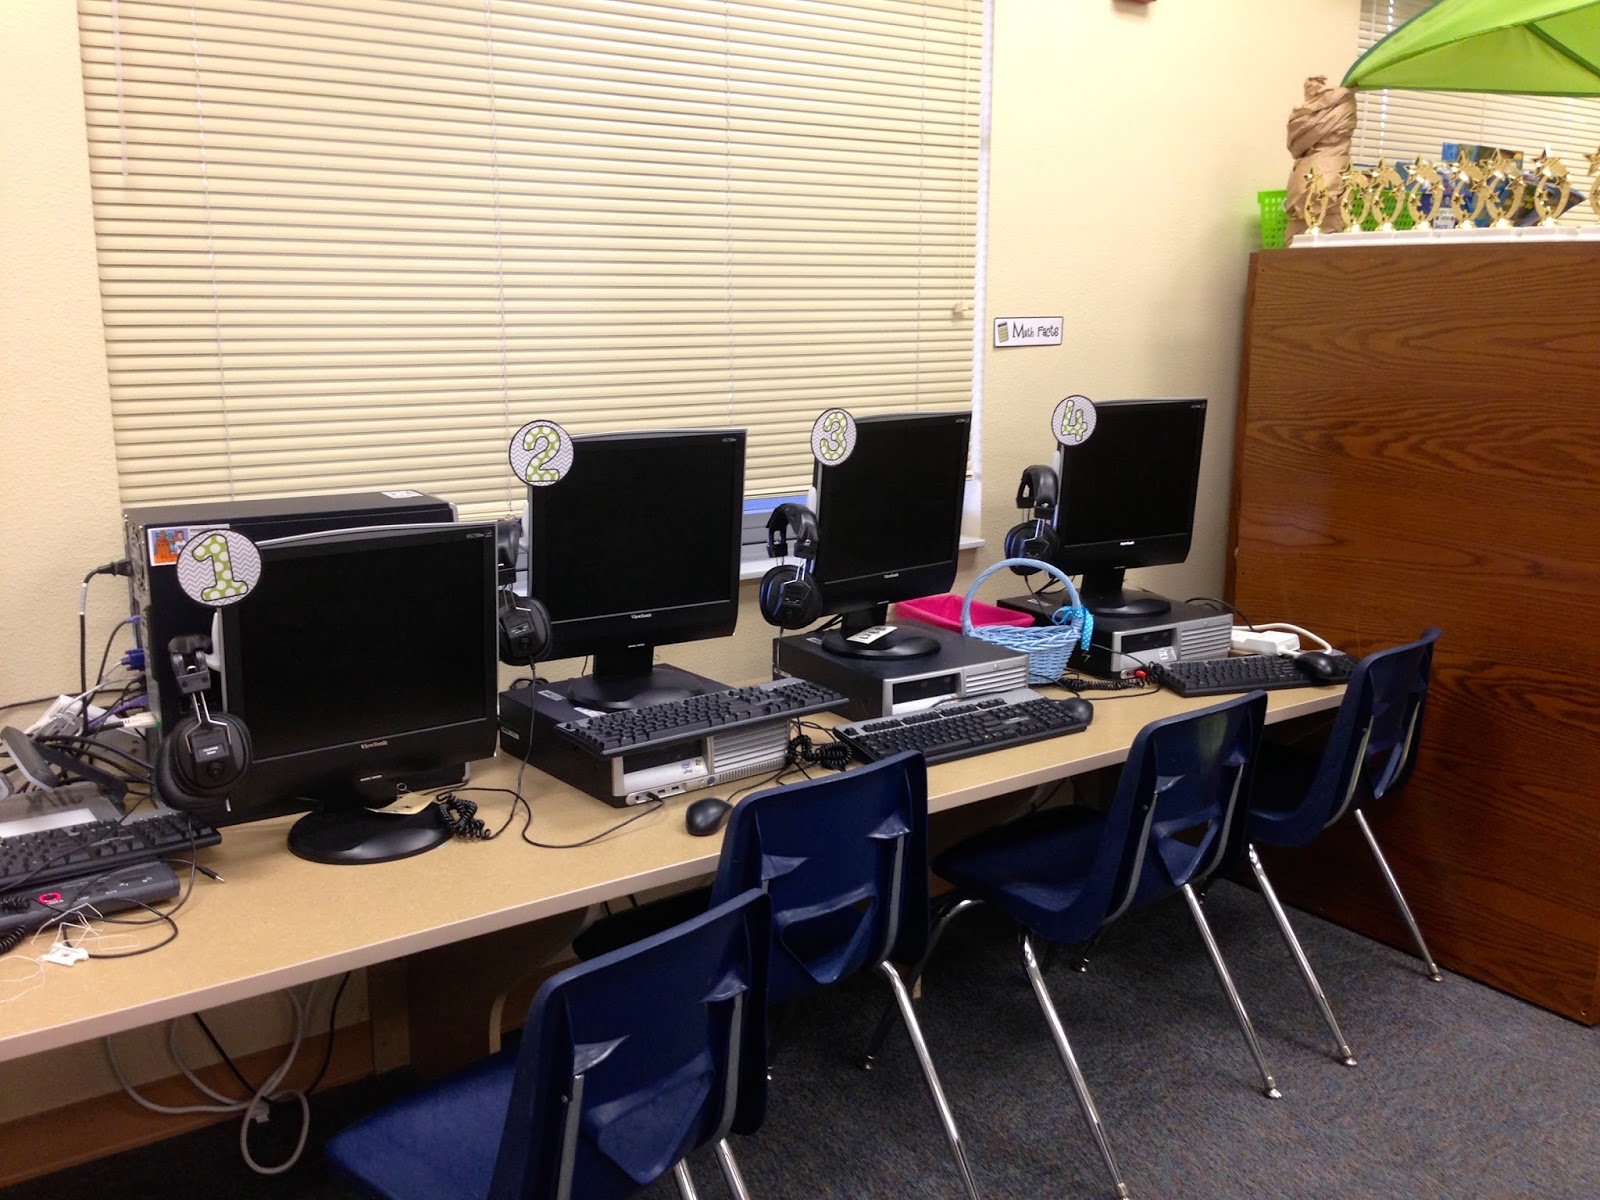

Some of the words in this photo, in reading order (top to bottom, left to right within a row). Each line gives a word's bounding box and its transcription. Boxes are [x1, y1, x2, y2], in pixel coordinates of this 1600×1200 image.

[1012, 321, 1034, 339] Math
[1037, 325, 1060, 338] Facts
[820, 411, 848, 461] 3
[1061, 400, 1088, 442] 4
[523, 425, 561, 482] 2
[191, 533, 249, 602] 1
